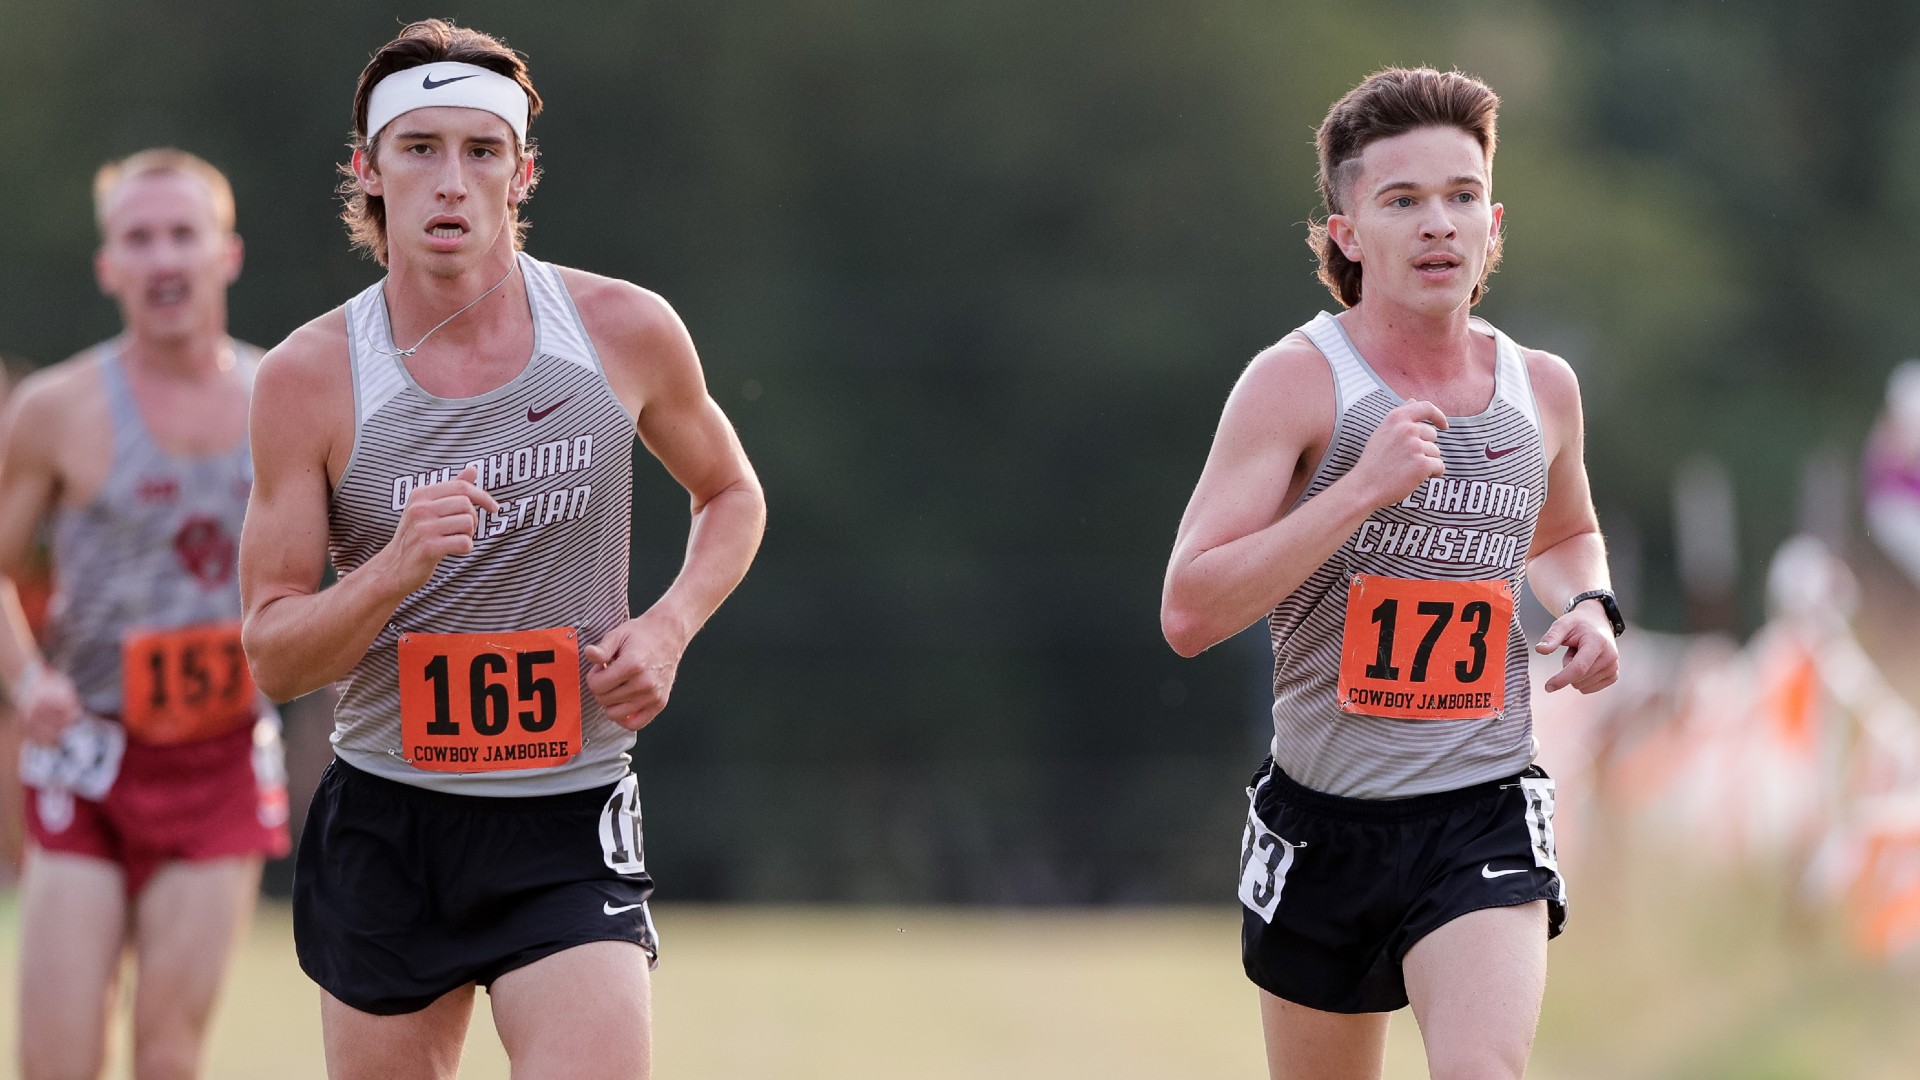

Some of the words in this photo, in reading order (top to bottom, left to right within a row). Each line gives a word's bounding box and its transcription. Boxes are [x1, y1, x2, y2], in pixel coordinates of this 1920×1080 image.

[474, 484, 592, 540] ISTIAN
[1391, 476, 1530, 521] LAHOMA
[1353, 520, 1519, 569] CHRISTIAN
[1365, 598, 1492, 684] 173
[424, 650, 558, 736] 165
[1348, 687, 1415, 710] COWBOY
[1416, 692, 1492, 710] JAMBOREE
[414, 745, 479, 763] COWBOY
[483, 741, 569, 762] JAMBOREE
